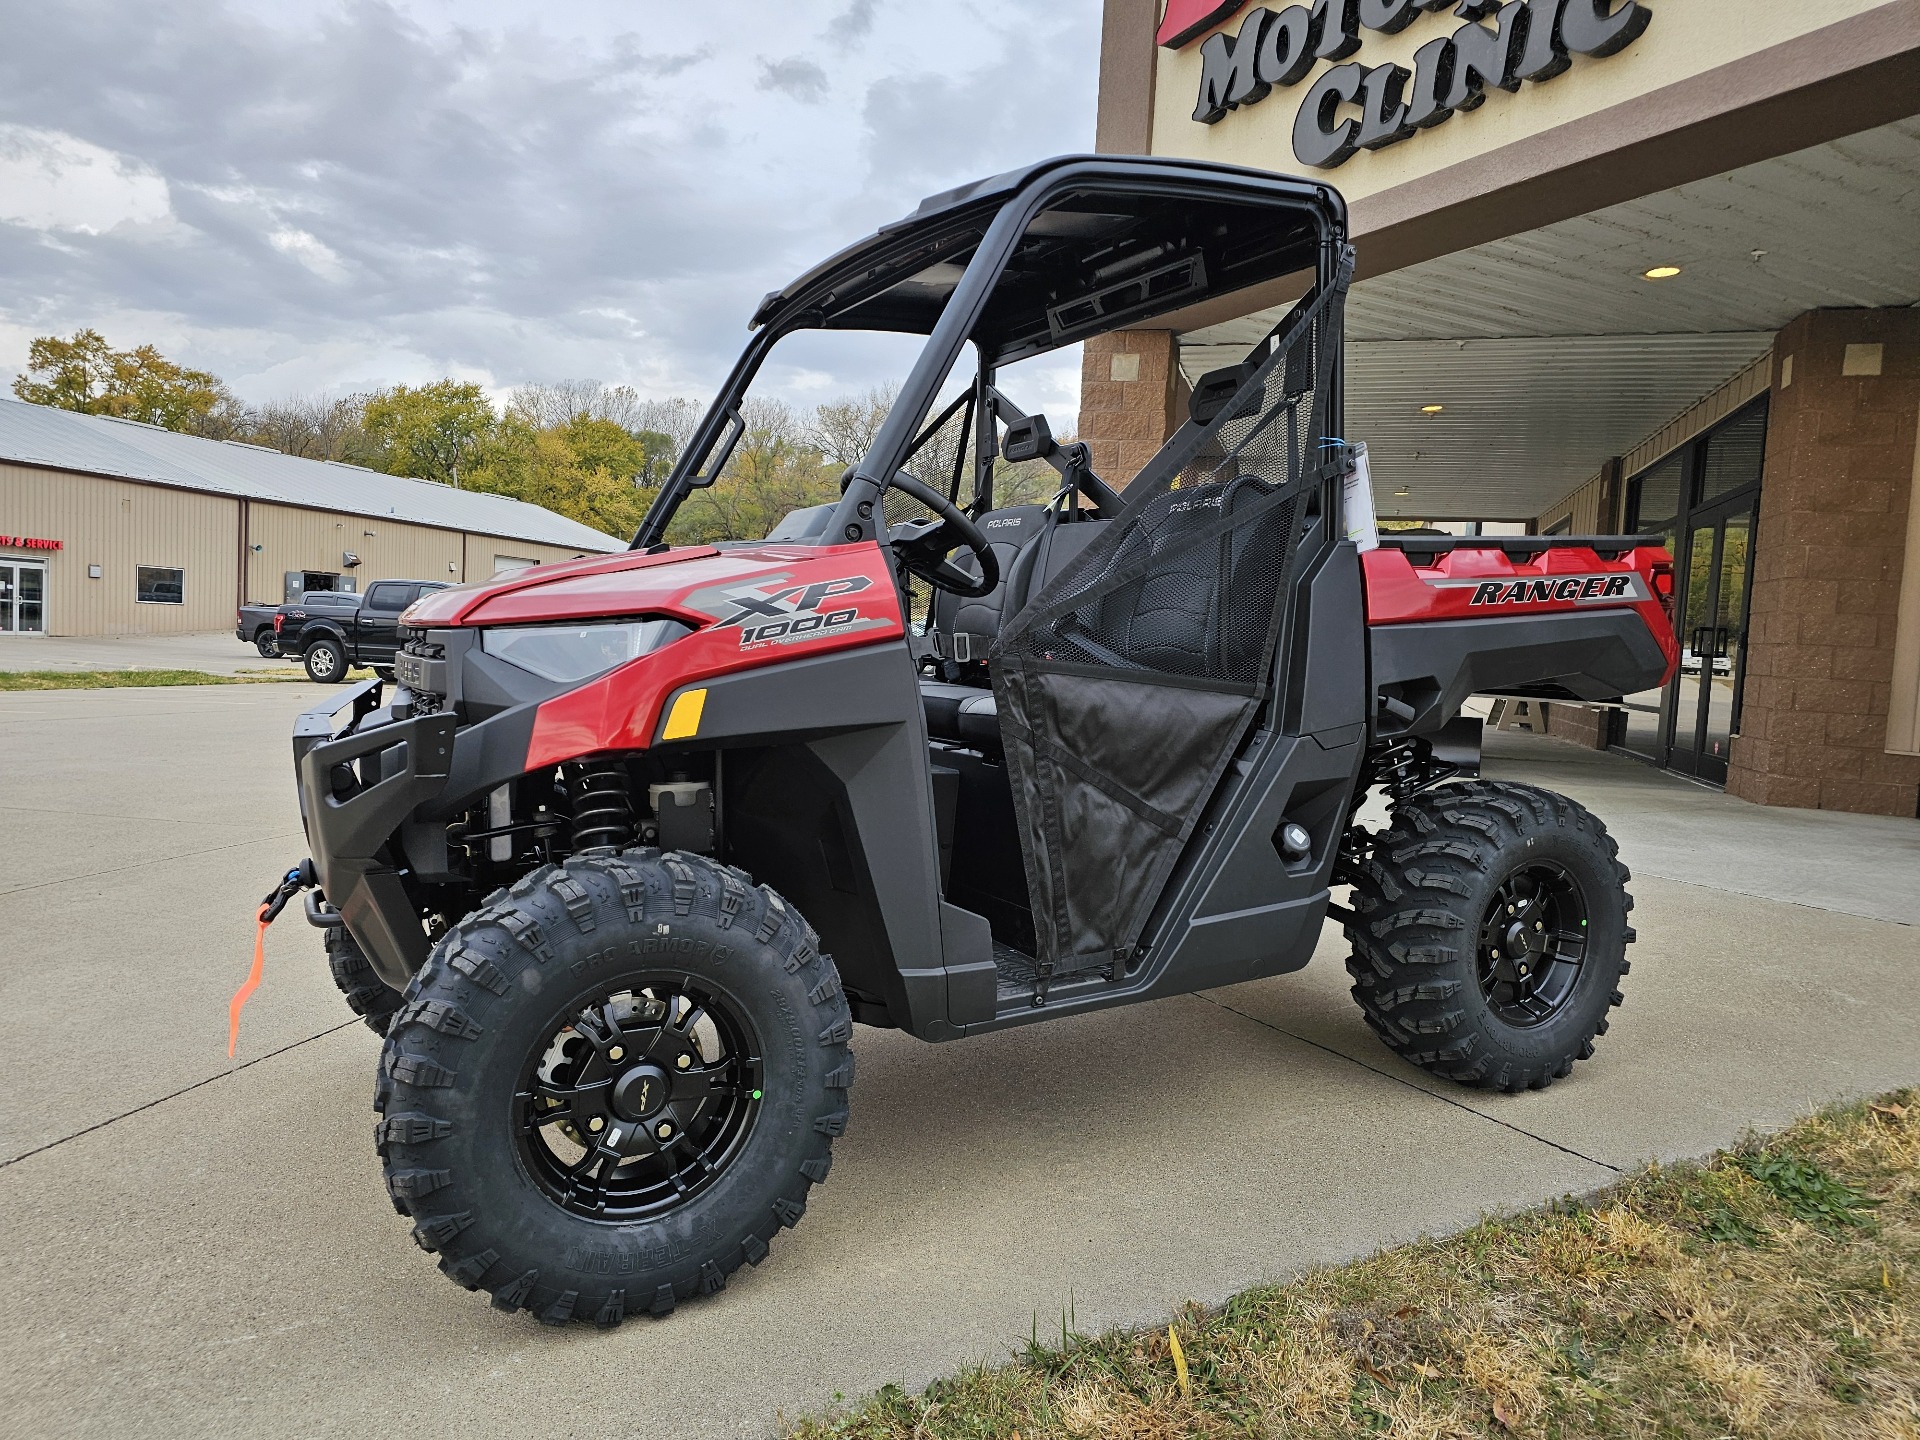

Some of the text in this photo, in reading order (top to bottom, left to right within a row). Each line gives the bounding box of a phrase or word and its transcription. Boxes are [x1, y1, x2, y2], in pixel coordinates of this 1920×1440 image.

[987, 518, 1022, 529] POLARIS
[0, 535, 64, 551] TS & SERVICE
[701, 575, 874, 634] XP
[1469, 574, 1631, 606] RANGER
[739, 608, 858, 646] 1000
[740, 625, 852, 652] DUAL OVERHEAD CAM
[569, 946, 617, 978] PRO
